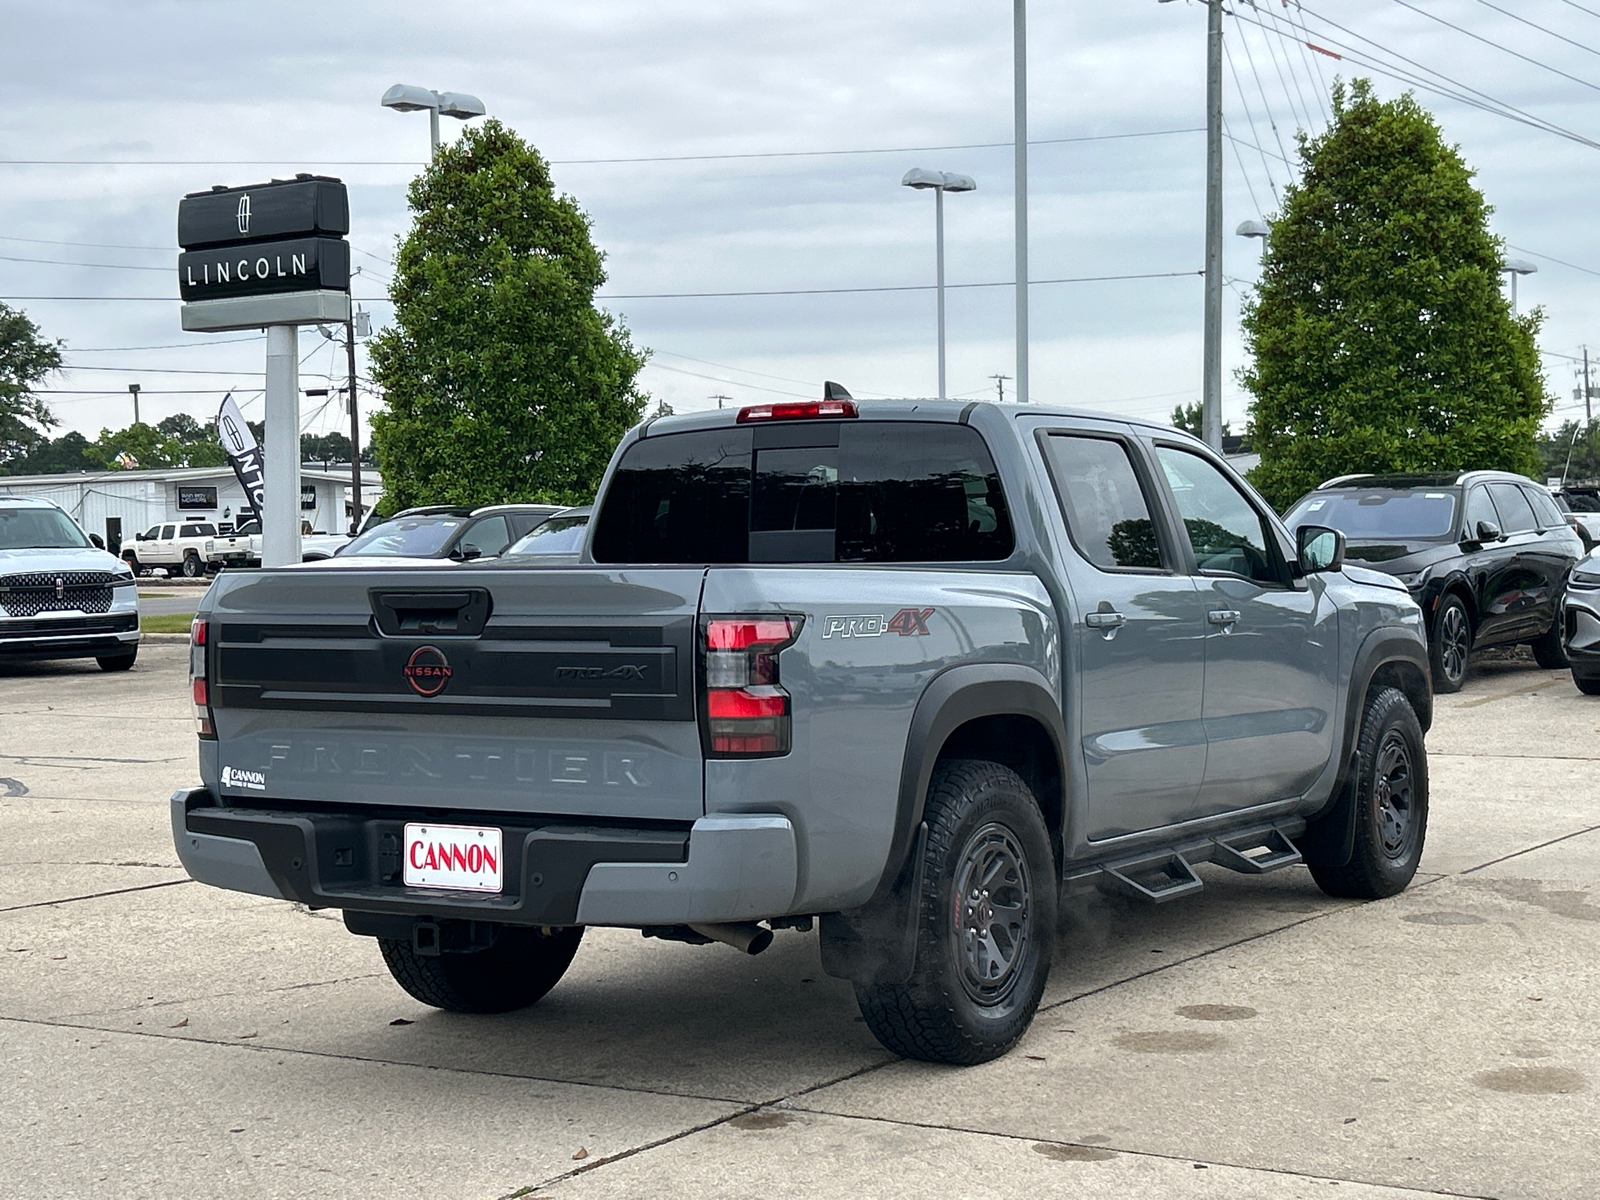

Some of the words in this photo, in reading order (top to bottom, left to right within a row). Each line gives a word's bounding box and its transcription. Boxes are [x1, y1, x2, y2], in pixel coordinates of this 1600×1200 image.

[187, 253, 306, 286] LINCOLN
[403, 666, 452, 677] NISSAN
[231, 768, 265, 784] CANNON
[256, 739, 652, 787] FRONTIER
[410, 840, 497, 875] CANNON
